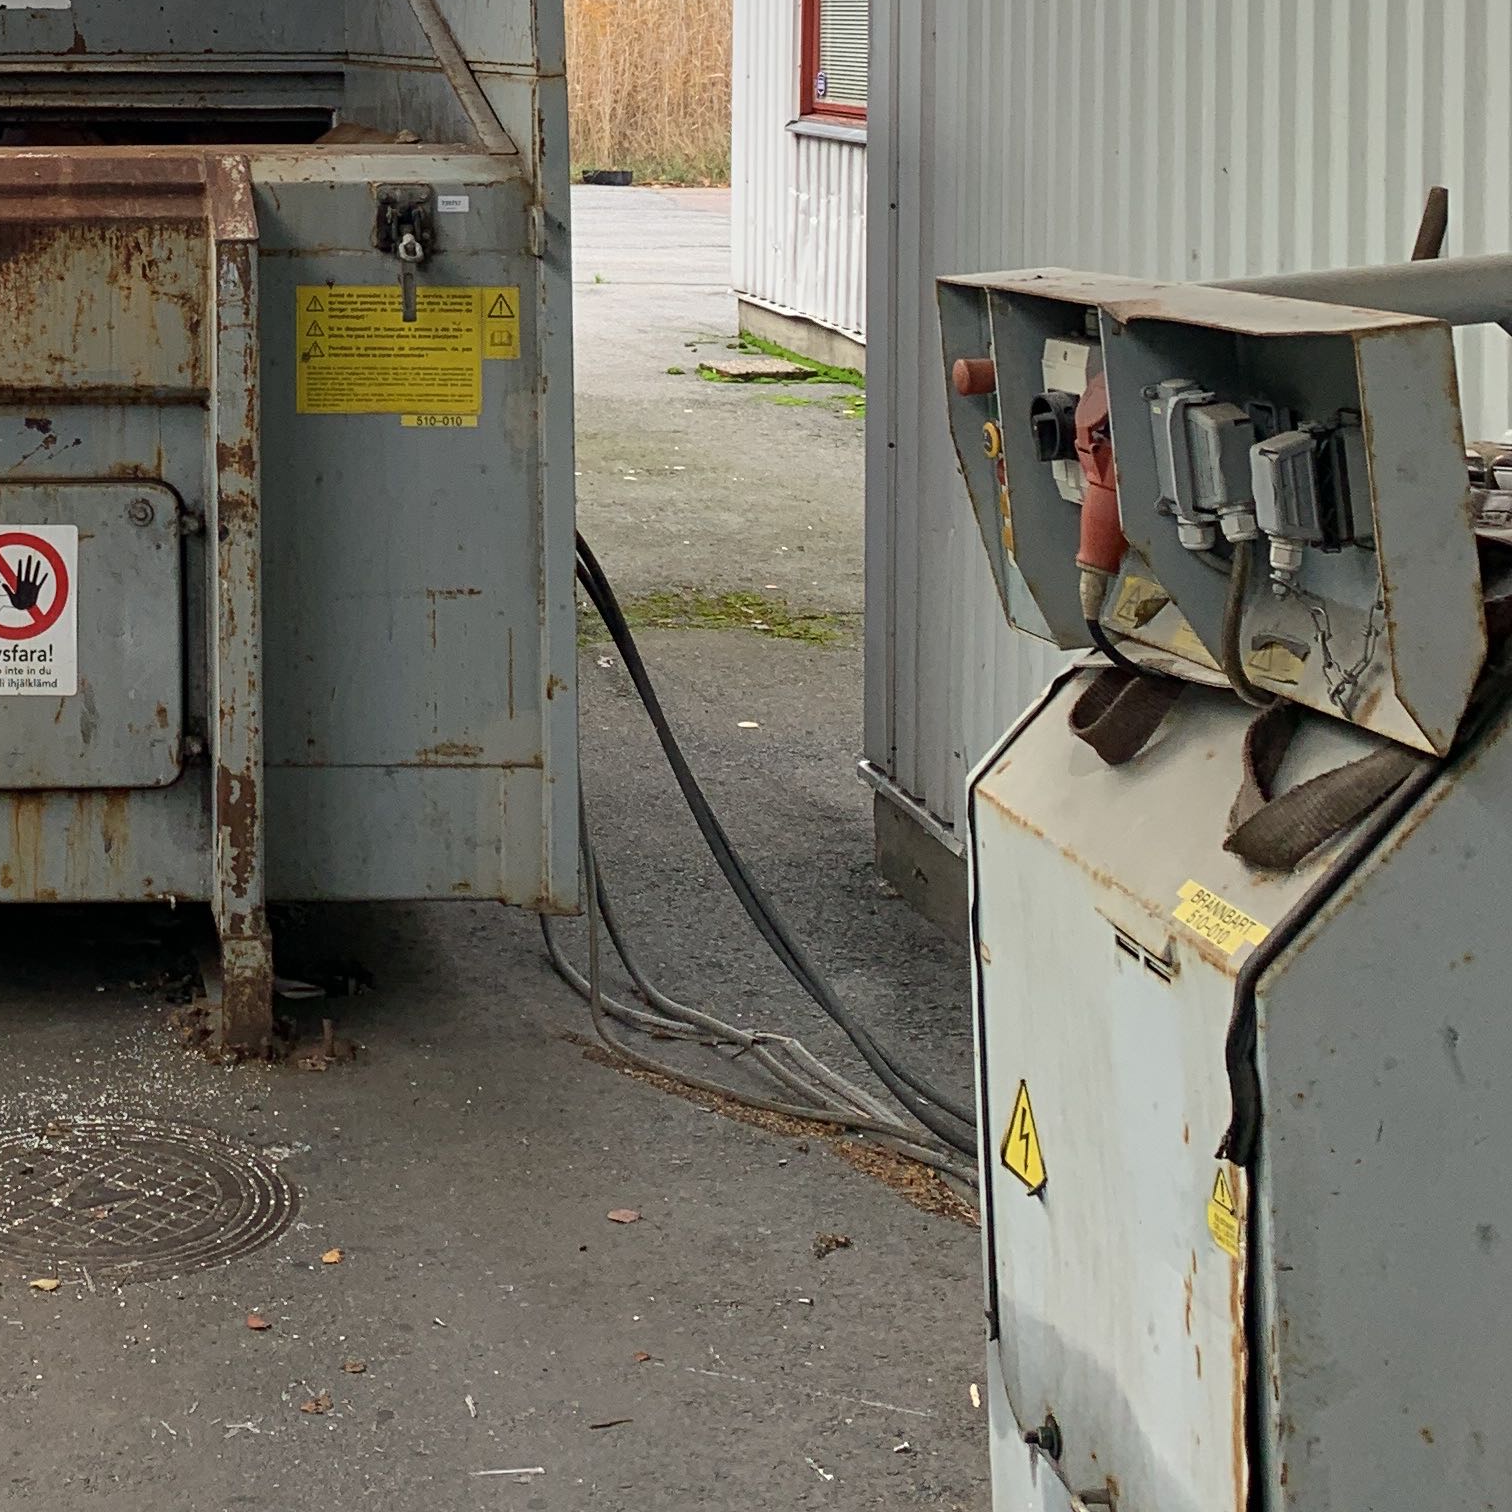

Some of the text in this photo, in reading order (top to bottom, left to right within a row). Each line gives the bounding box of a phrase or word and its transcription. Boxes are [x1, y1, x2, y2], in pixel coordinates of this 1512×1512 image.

[416, 415, 463, 426] 510-010
[4, 666, 24, 675] inte
[26, 666, 36, 675] in
[38, 666, 52, 675] du
[1186, 909, 1231, 945] 510-010
